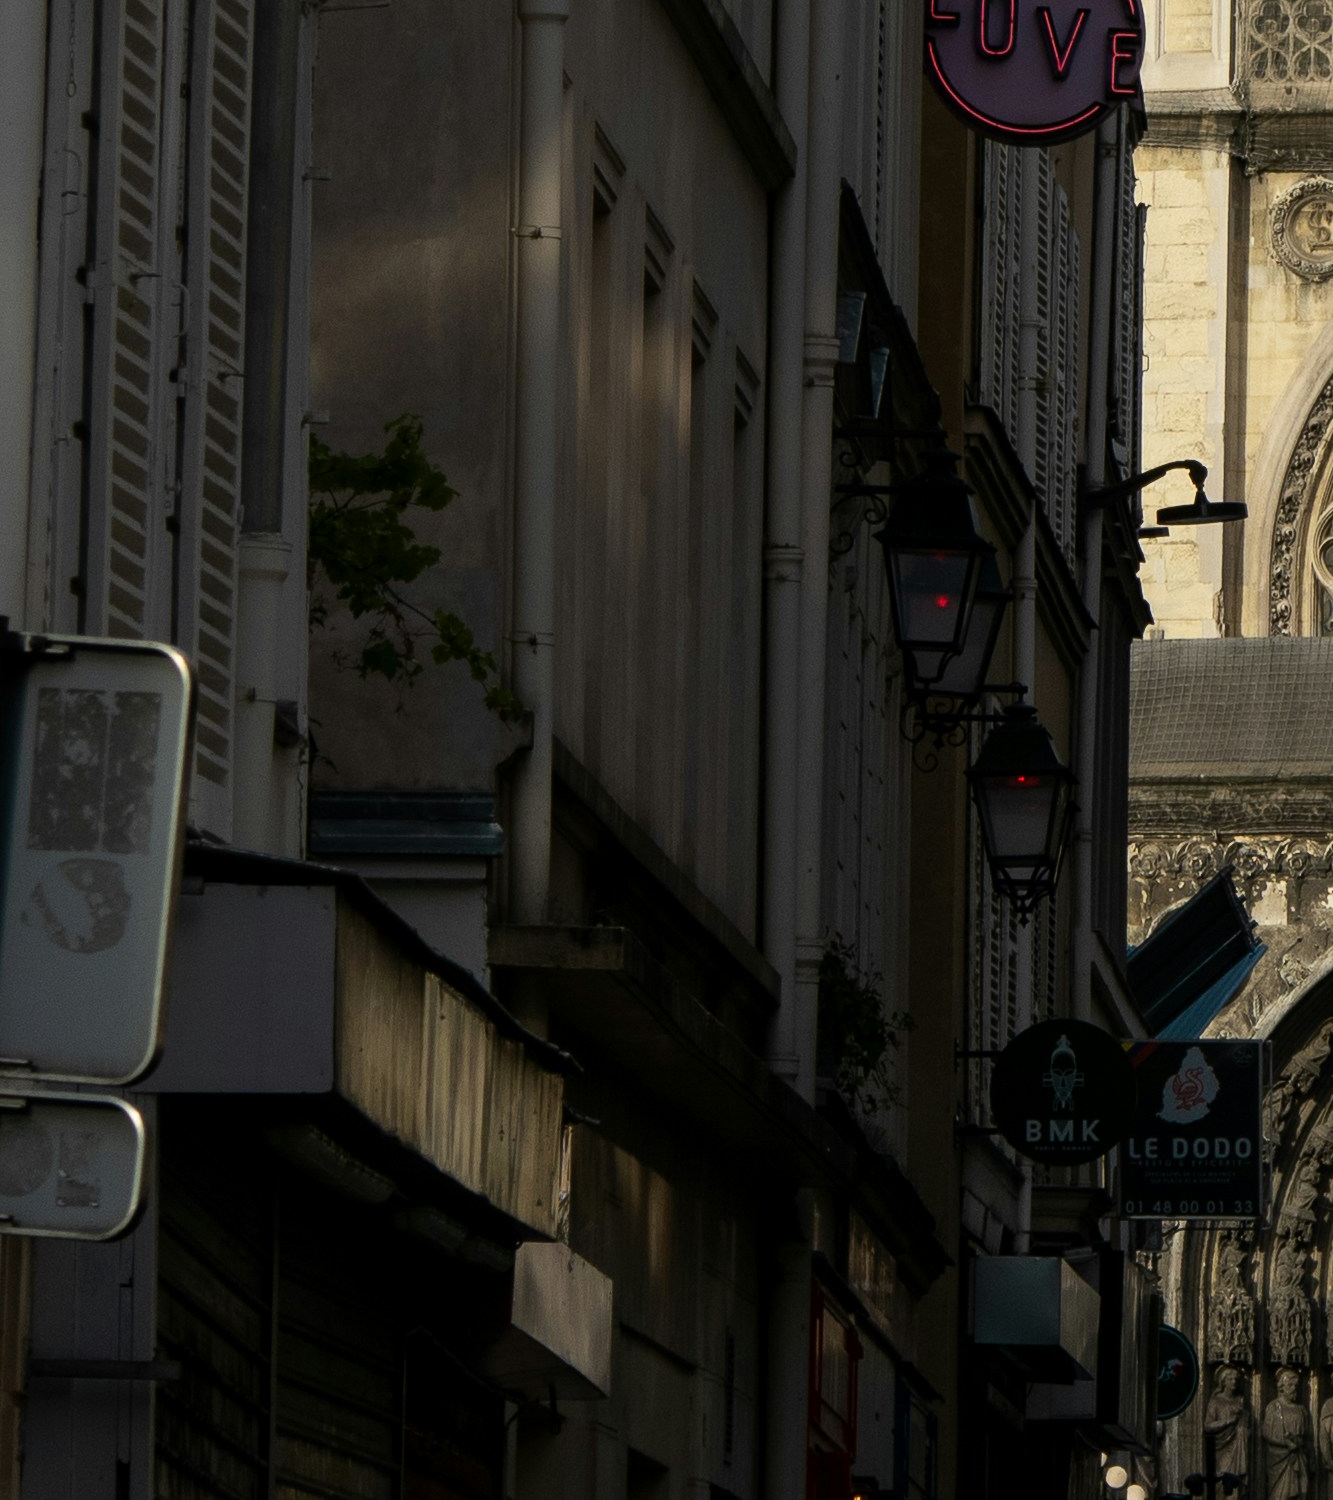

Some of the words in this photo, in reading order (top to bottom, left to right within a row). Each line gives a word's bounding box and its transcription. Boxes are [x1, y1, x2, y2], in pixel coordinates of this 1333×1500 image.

[1025, 1118, 1100, 1143] BMK
[1127, 1137, 1159, 1159] LE
[1172, 1137, 1252, 1160] DODO
[1125, 1200, 1144, 1214] 01
[1153, 1200, 1173, 1214] 48
[1179, 1200, 1200, 1214] 00
[1206, 1200, 1225, 1214] 01
[1234, 1200, 1254, 1214] 33
